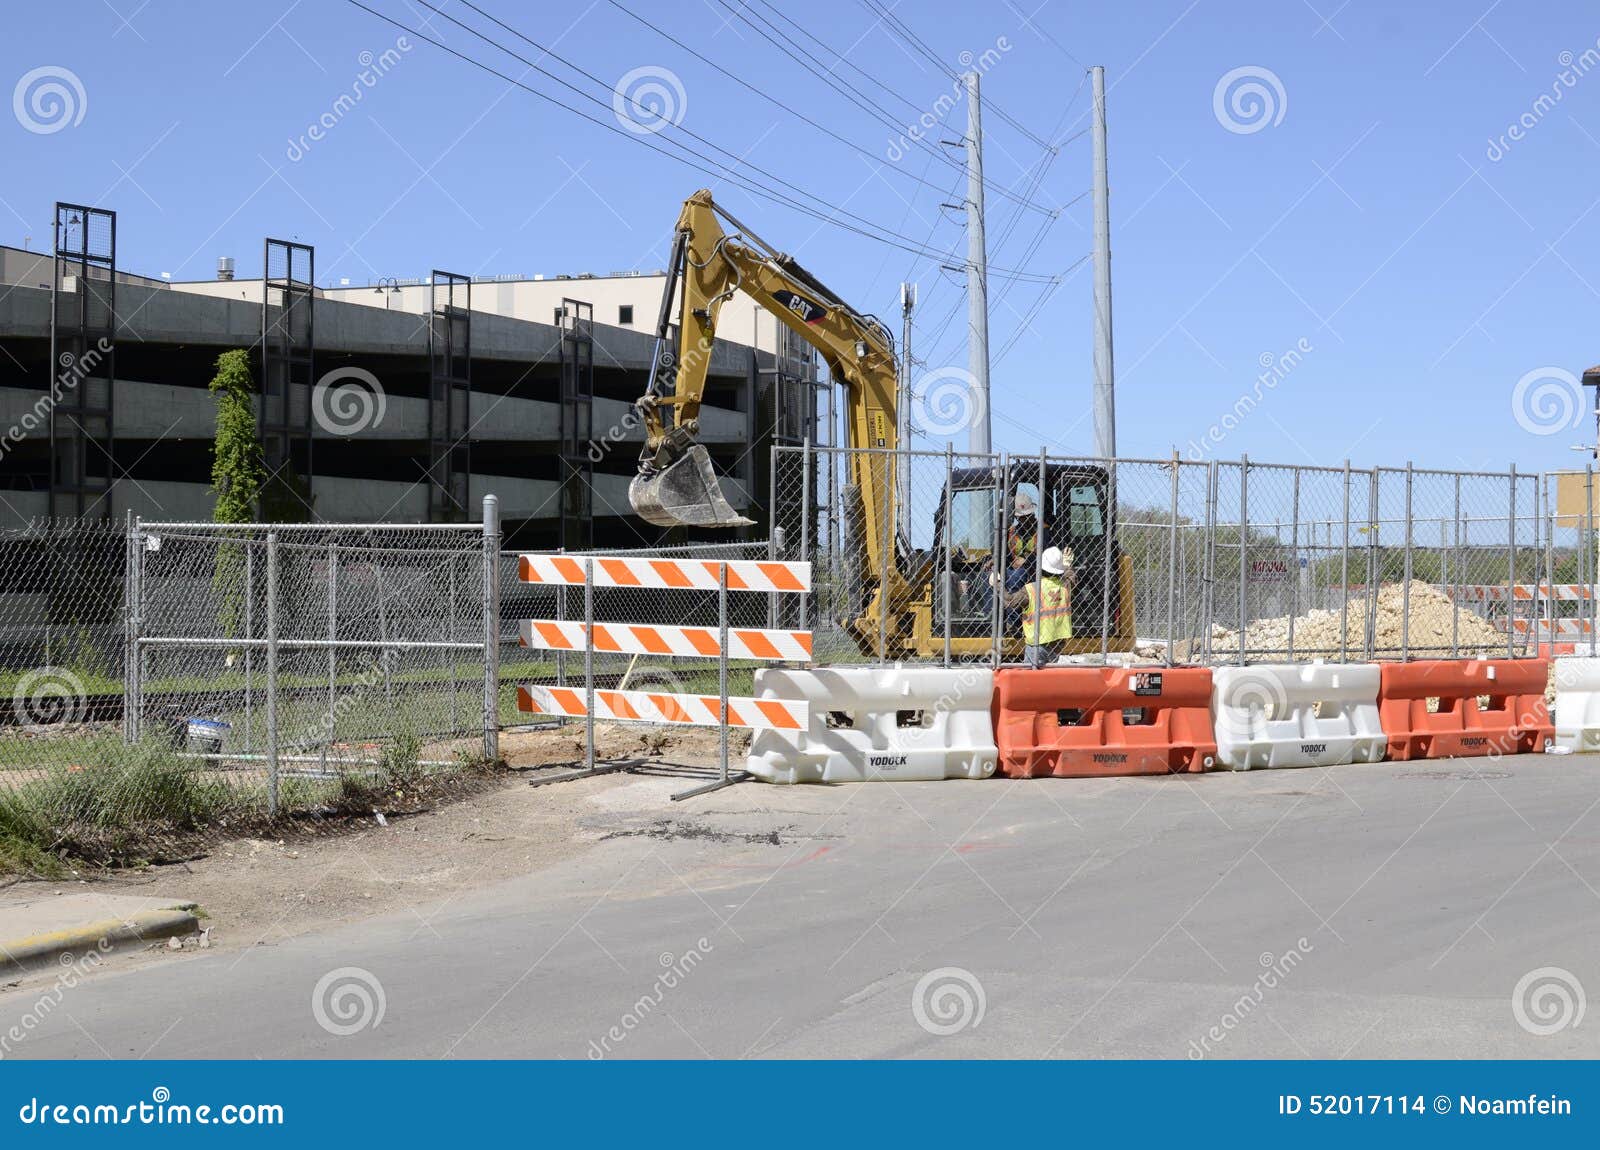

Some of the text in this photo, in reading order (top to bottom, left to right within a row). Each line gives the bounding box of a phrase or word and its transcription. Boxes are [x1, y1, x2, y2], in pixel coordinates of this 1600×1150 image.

[789, 295, 813, 320] CAT
[1460, 737, 1488, 746] YODOCK
[1301, 743, 1327, 753] YODOCK
[870, 756, 908, 767] YODOCK
[1093, 754, 1128, 764] YODOCK
